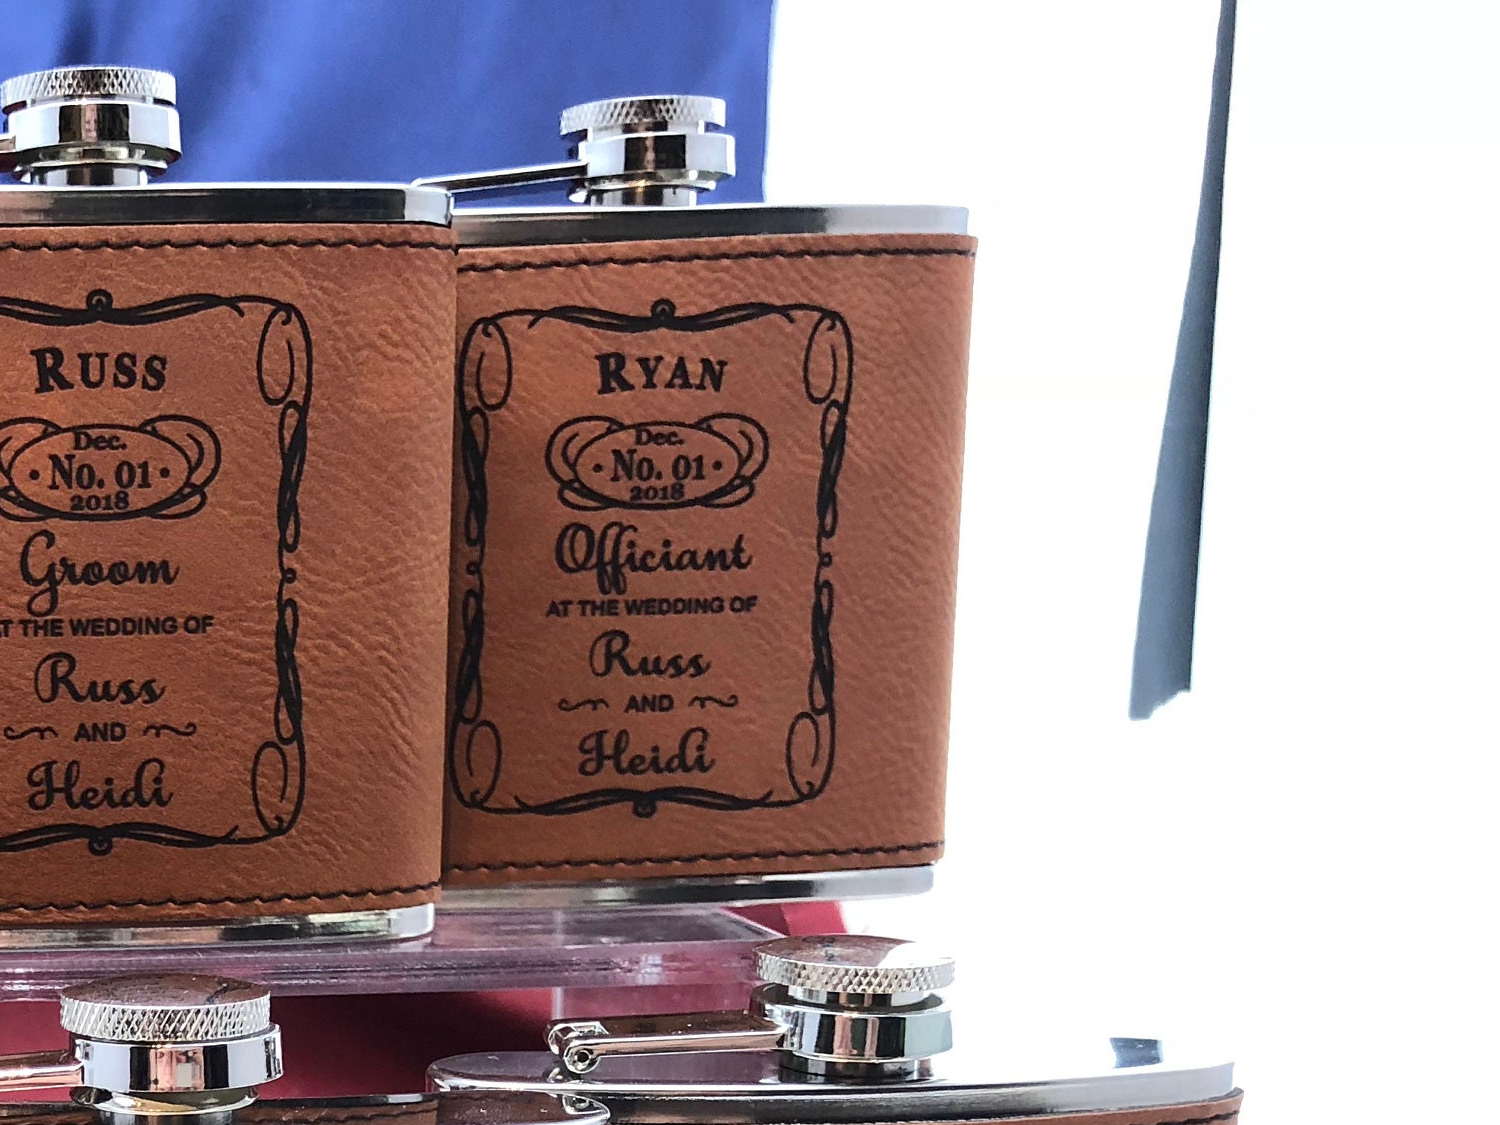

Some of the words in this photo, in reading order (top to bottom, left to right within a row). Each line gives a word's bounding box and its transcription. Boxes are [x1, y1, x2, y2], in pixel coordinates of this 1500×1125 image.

[30, 346, 167, 394] RUSS
[595, 352, 728, 395] RYAN
[73, 431, 127, 451] Dec.
[634, 428, 684, 446] Dec.
[48, 454, 105, 490] No.
[115, 460, 151, 489] 01
[611, 449, 662, 482] No.
[672, 455, 705, 480] 01
[70, 493, 129, 511] 2018
[630, 484, 684, 500] 2018
[20, 529, 180, 618] Groom
[554, 521, 752, 595] Officiant
[546, 600, 573, 617] AT
[577, 599, 620, 616] THE
[626, 597, 724, 616] WEDDING
[730, 595, 757, 613] OF
[20, 619, 64, 637] THE
[69, 617, 178, 636] WEDDING
[184, 615, 214, 634] OF
[589, 629, 710, 678] Russ
[34, 651, 165, 705] Russ
[624, 694, 674, 713] AND
[74, 722, 126, 742] AND
[578, 727, 715, 776] Heidi
[27, 758, 173, 810] Heidi
